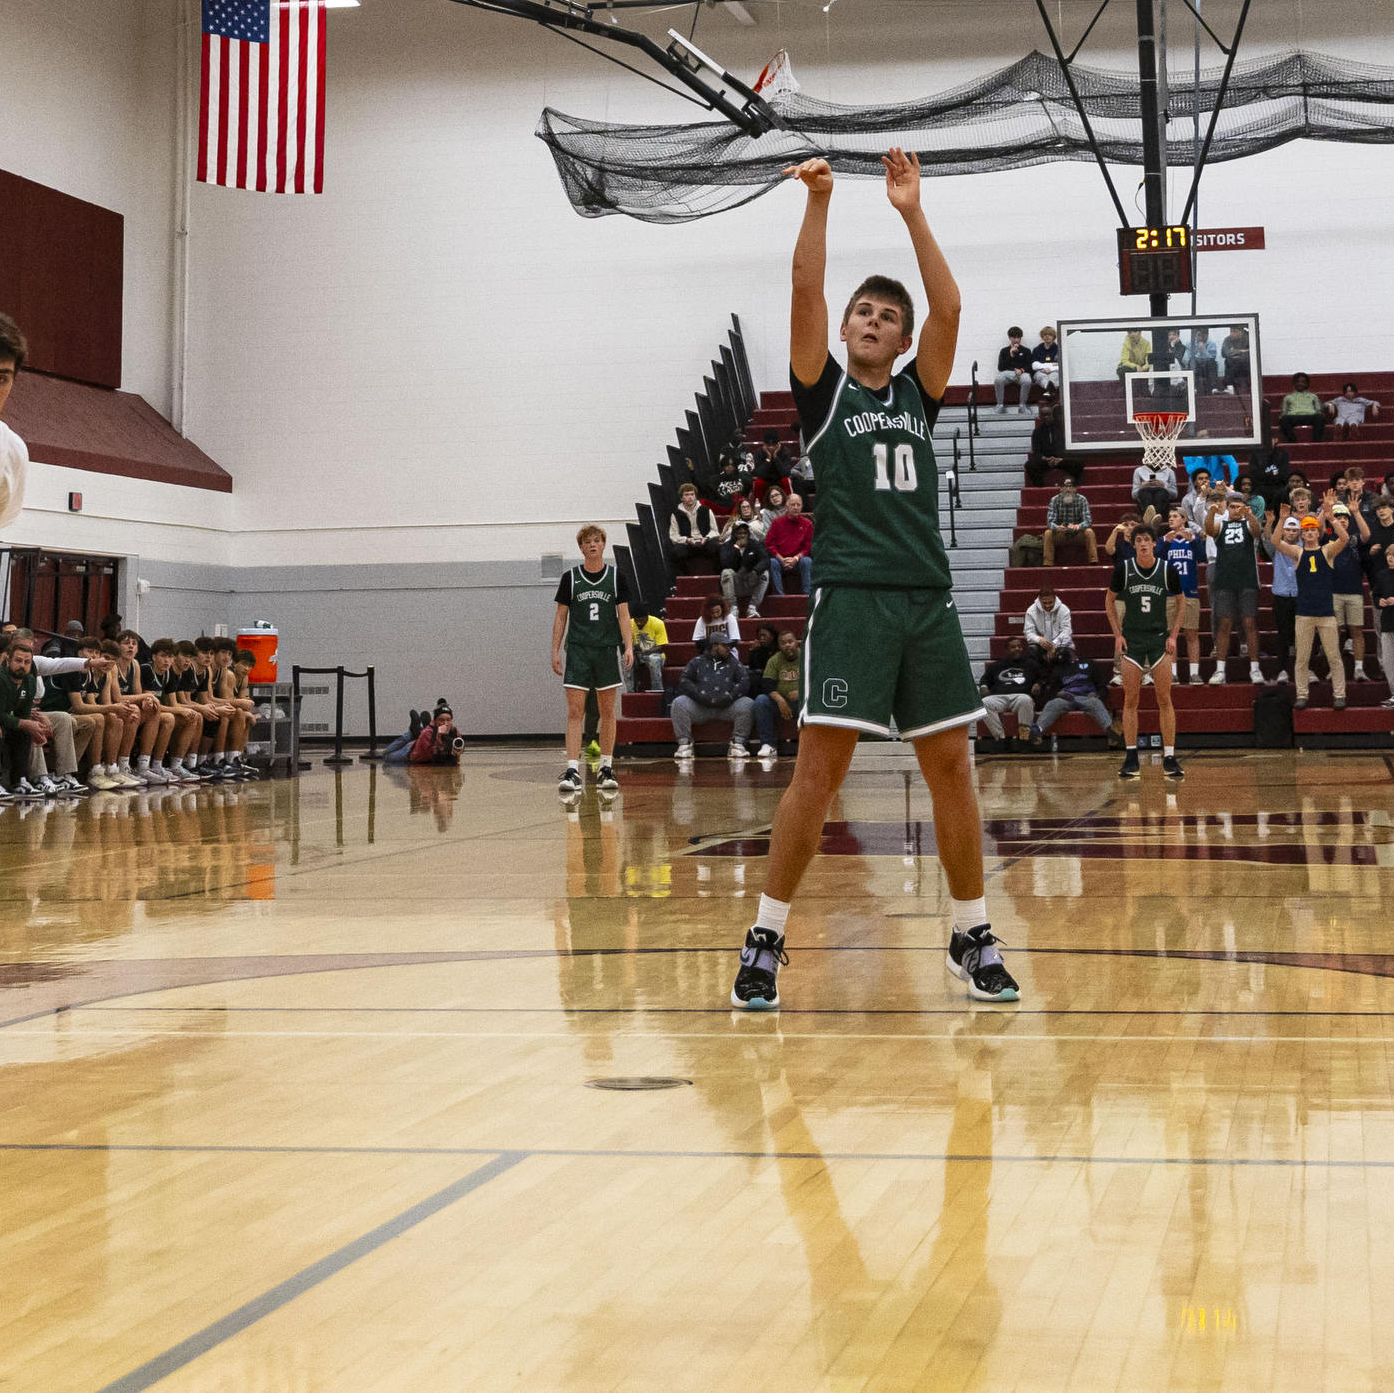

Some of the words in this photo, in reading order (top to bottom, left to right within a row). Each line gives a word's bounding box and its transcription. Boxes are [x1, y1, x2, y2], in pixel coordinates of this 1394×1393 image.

[1136, 227, 1186, 249] 2:17
[873, 443, 918, 491] 10
[1224, 527, 1244, 544] 23
[1168, 549, 1193, 561] PHILA
[1309, 555, 1317, 573] 1
[577, 590, 612, 603] COOPERSVILLE
[1129, 584, 1163, 596] COOPERSVILLE
[589, 603, 599, 621] 2
[1141, 596, 1151, 613] 5
[822, 677, 848, 708] C
